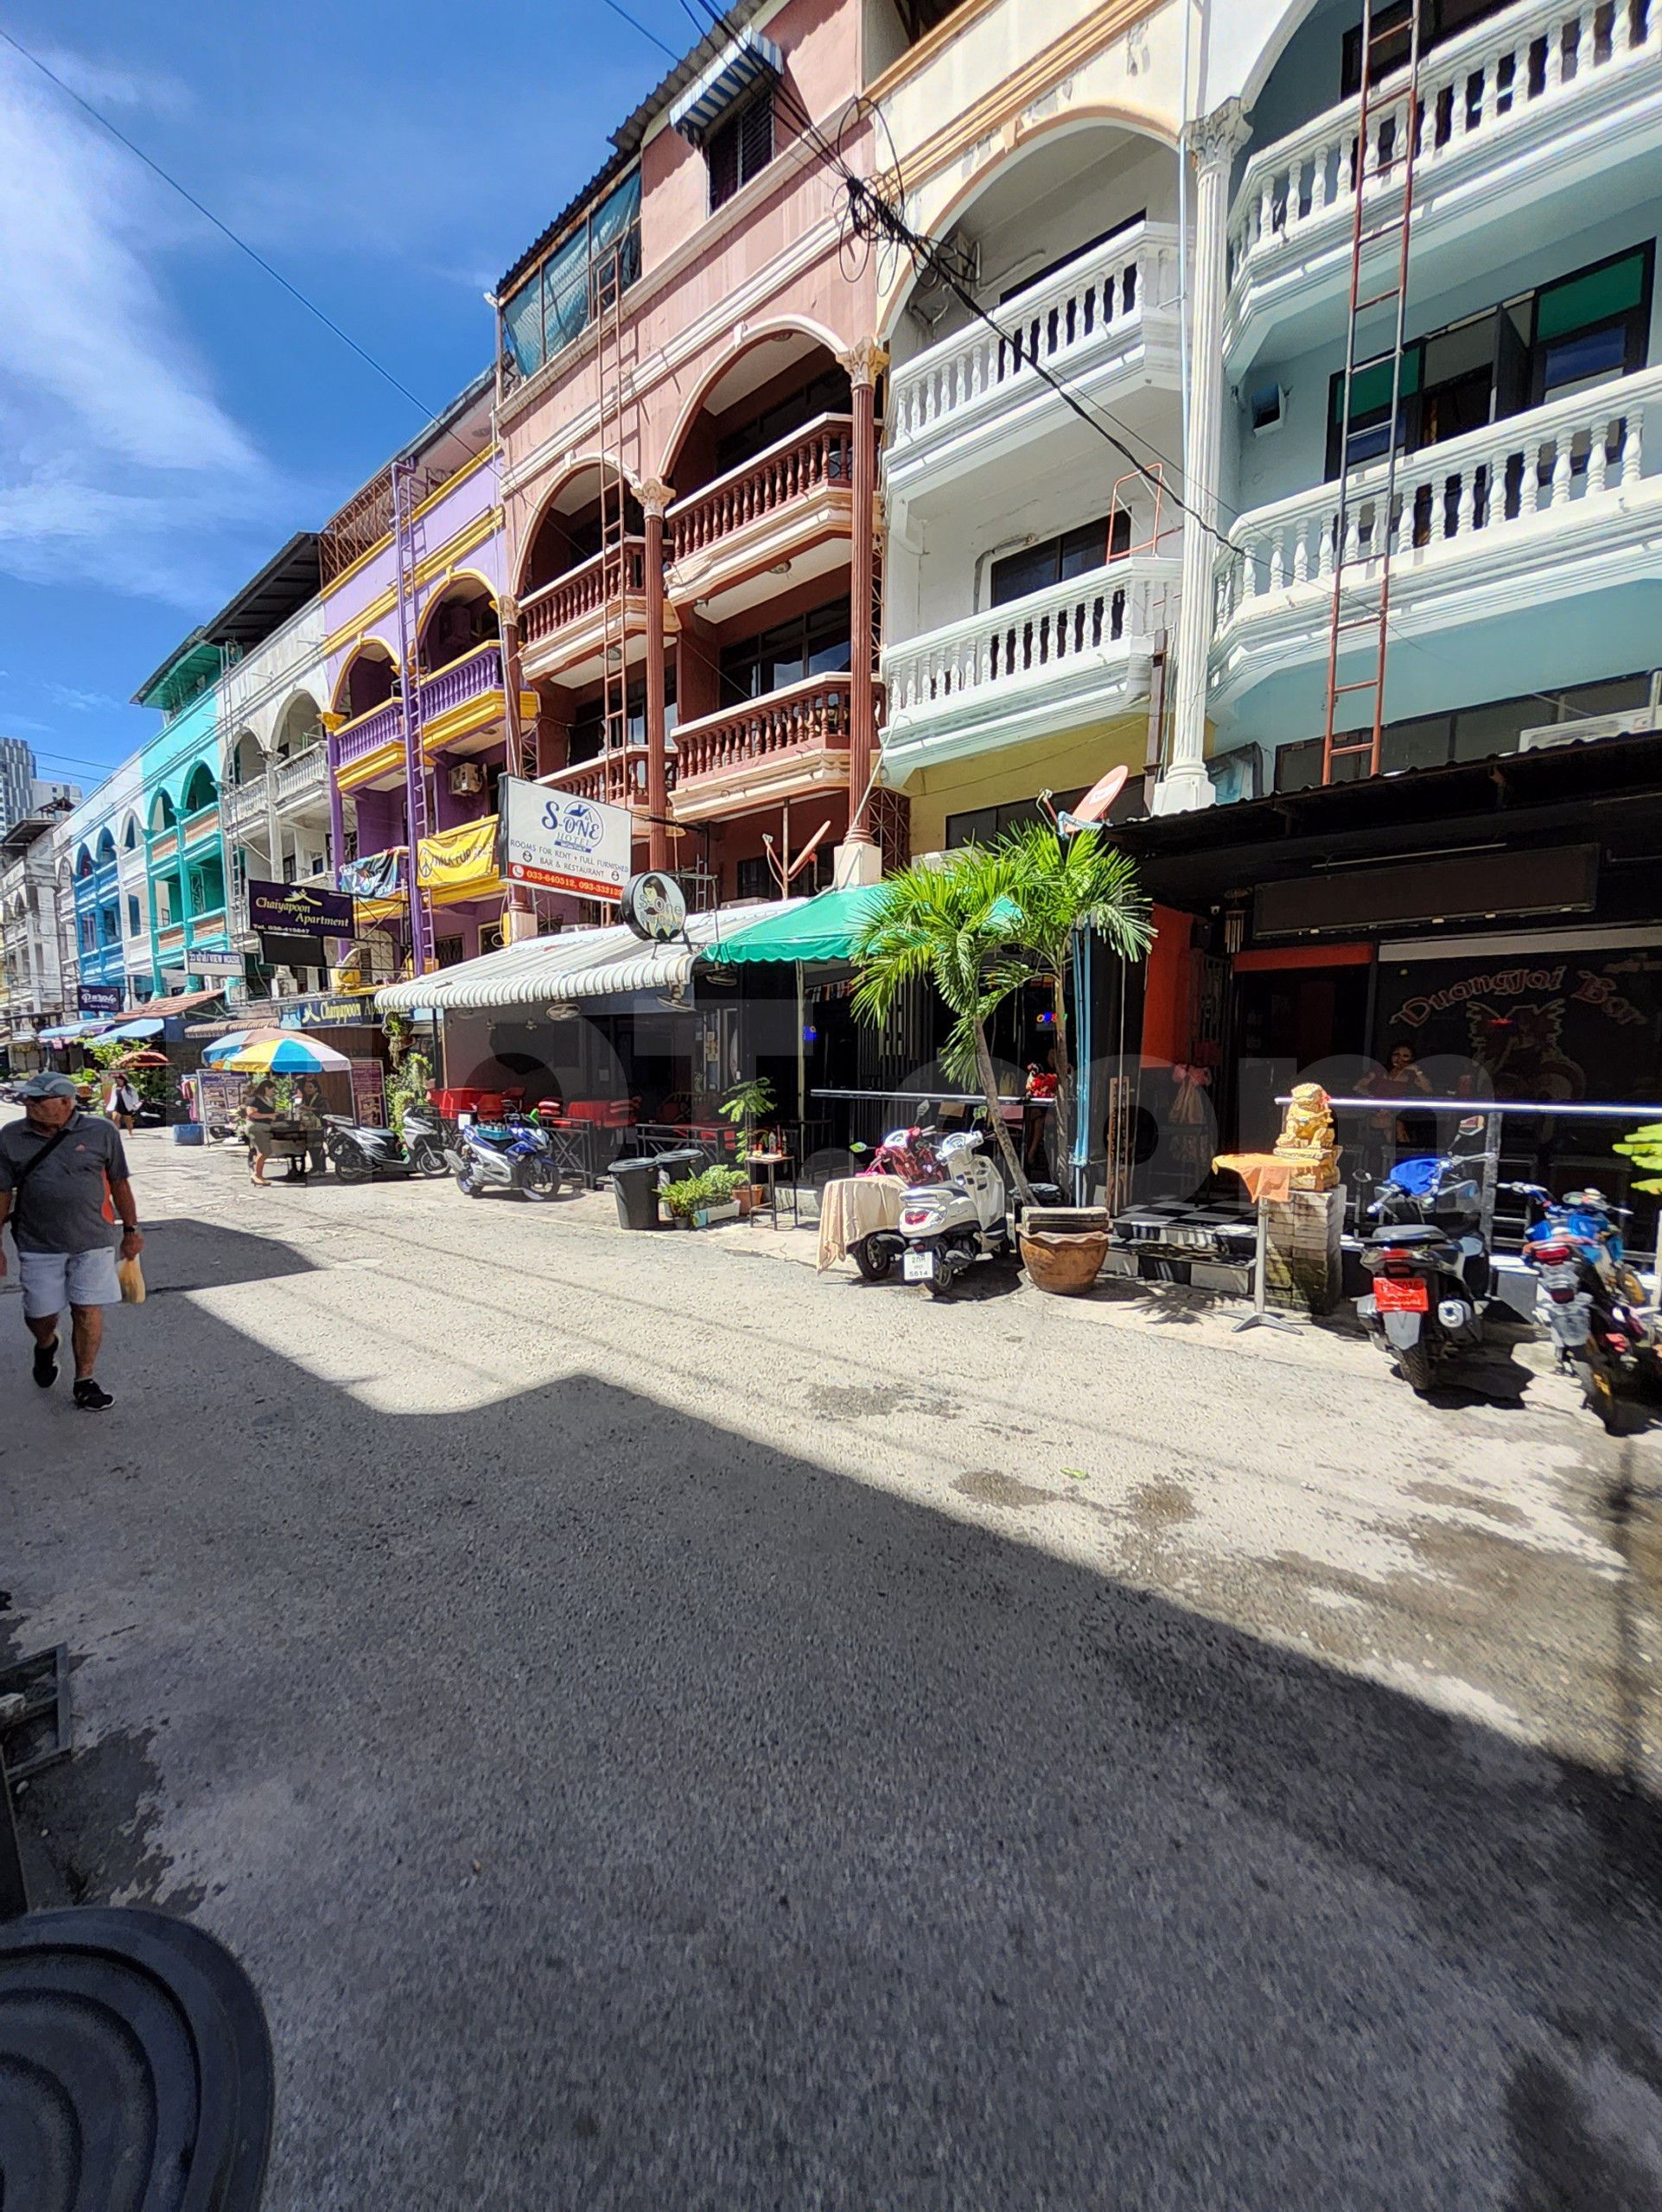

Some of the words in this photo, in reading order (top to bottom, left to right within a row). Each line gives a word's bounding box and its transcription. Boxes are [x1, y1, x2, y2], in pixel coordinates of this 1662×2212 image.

[510, 839, 537, 852] ROOMS
[539, 847, 552, 855] FOR
[555, 850, 571, 860] RENT
[580, 855, 595, 865] FULL
[597, 860, 628, 873] FURNISHED
[539, 857, 553, 867] BAR
[564, 862, 604, 877] RESTAURANT
[255, 897, 310, 914] Chaiyapoon
[295, 912, 349, 927] Apartment
